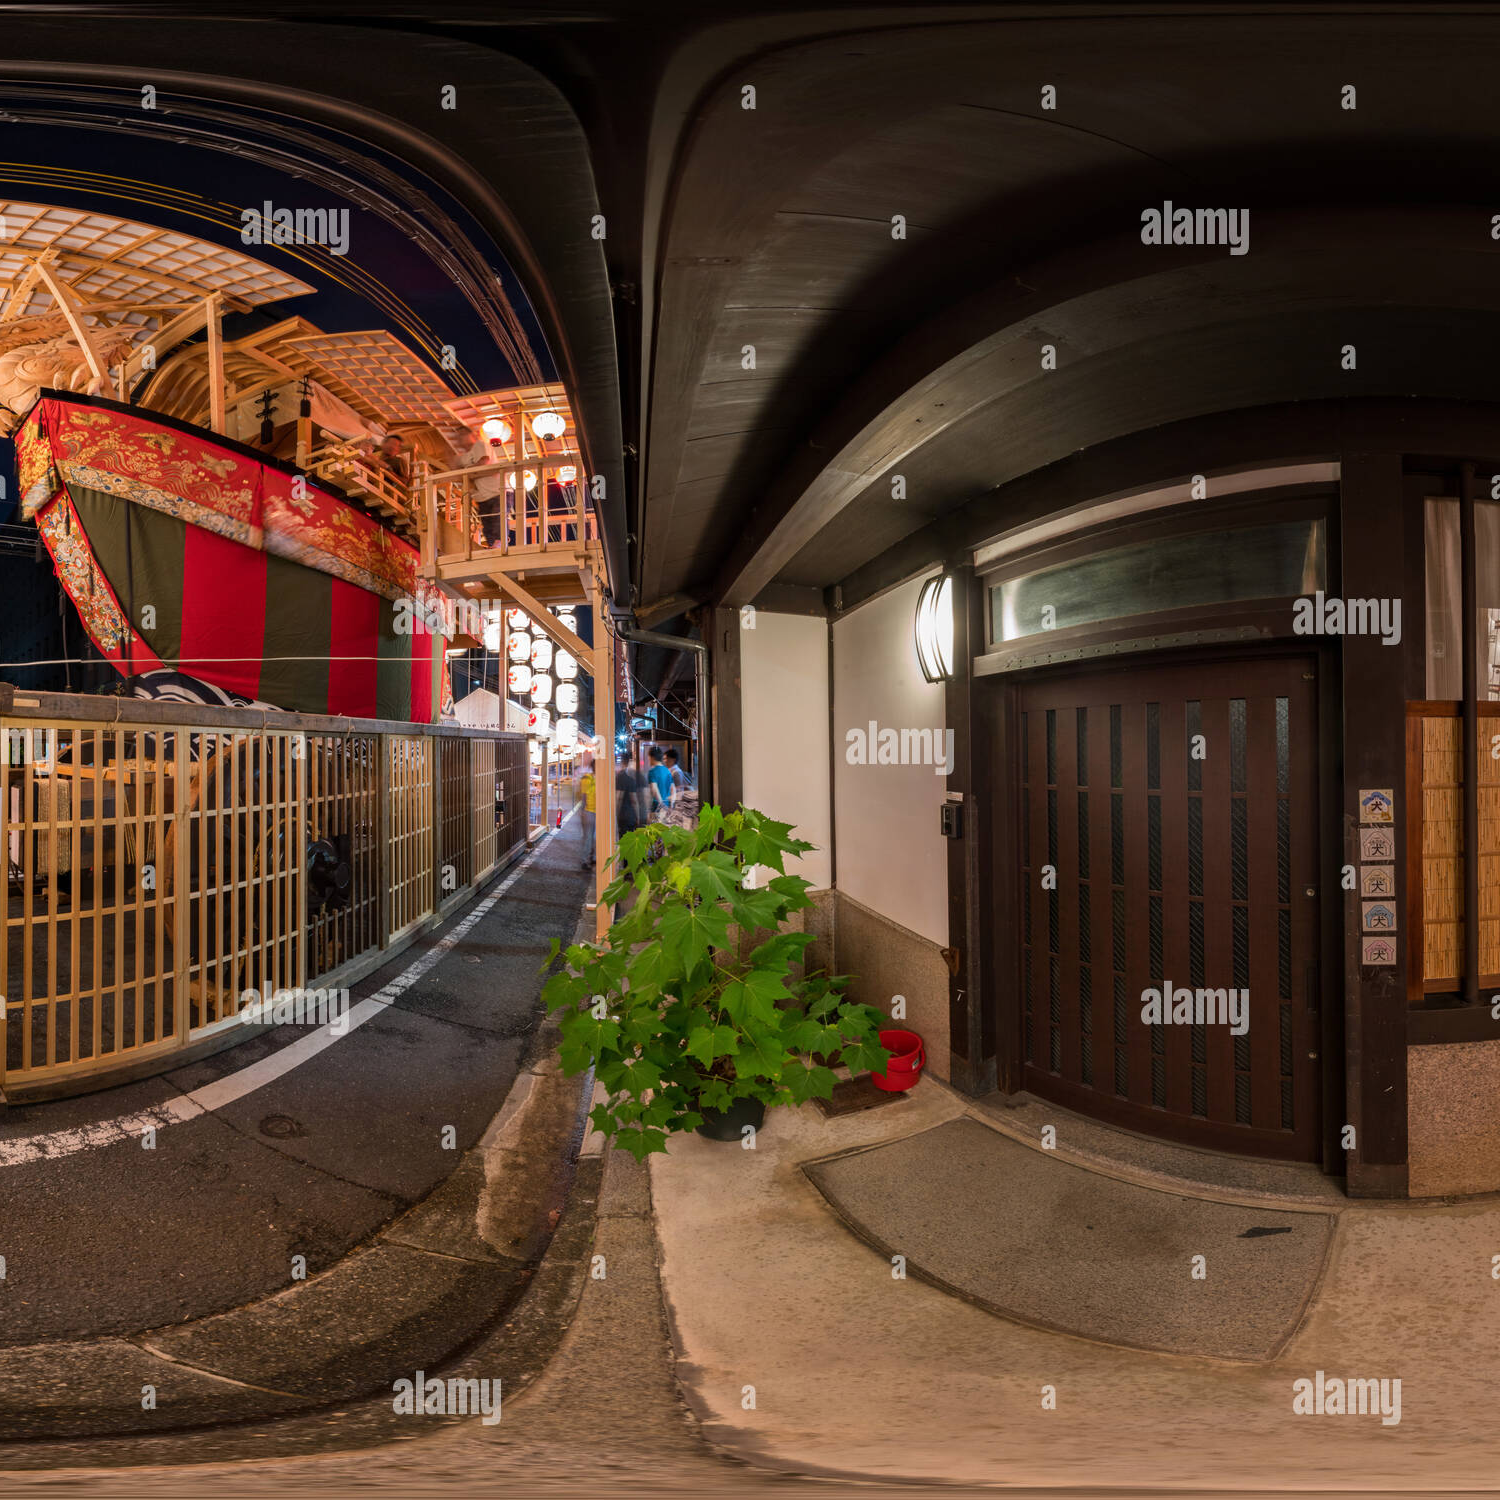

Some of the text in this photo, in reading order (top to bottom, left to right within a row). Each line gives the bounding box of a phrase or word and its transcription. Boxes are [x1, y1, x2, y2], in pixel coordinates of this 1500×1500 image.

[1371, 801, 1383, 812] 犬
[1371, 843, 1385, 856] 犬
[1371, 880, 1385, 893] 犬
[1373, 915, 1386, 928] 犬
[1373, 949, 1386, 961] 犬
